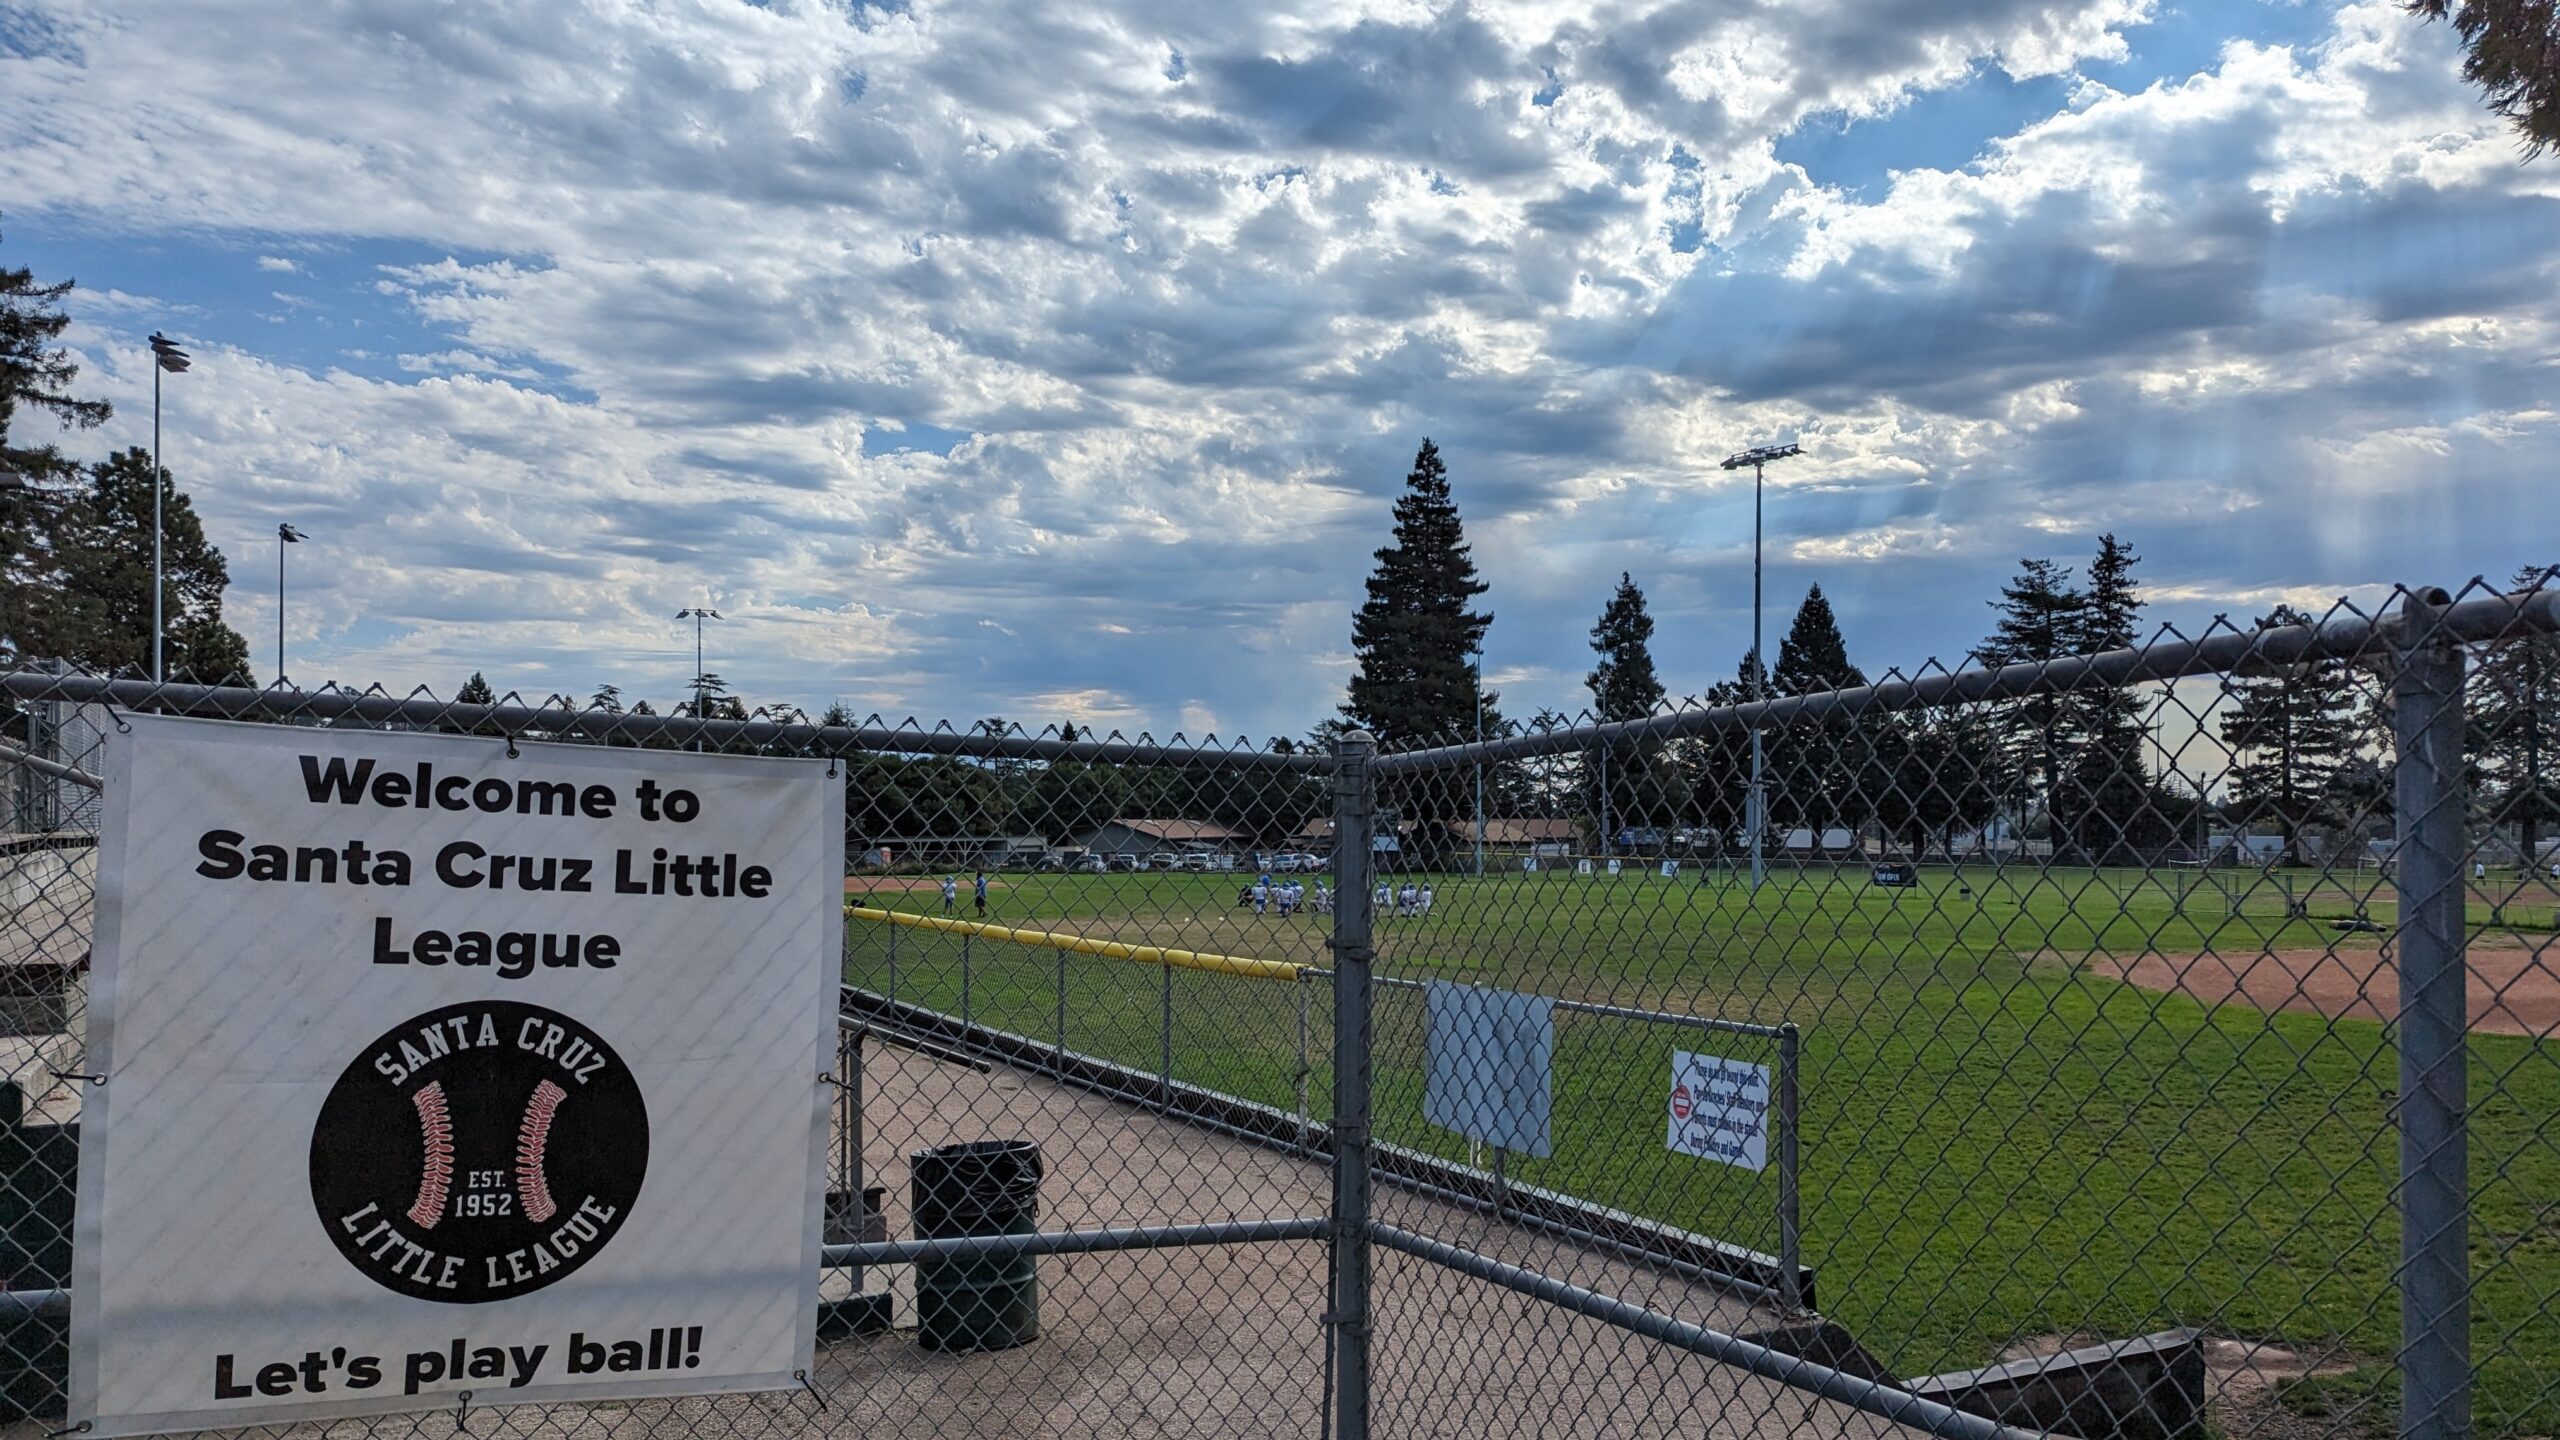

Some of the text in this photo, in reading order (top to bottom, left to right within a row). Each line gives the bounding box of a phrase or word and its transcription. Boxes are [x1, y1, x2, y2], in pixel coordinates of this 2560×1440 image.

[298, 755, 701, 823] Welcome to
[195, 829, 773, 899] Santa Cruz Little
[372, 916, 621, 980] League
[375, 1012, 607, 1087] SANTA CRUZ
[454, 1193, 513, 1217] 1952
[467, 1170, 507, 1188] EST.
[341, 1194, 617, 1290] LITTLE LEAGUE
[214, 1325, 704, 1400] Let's play ball!
